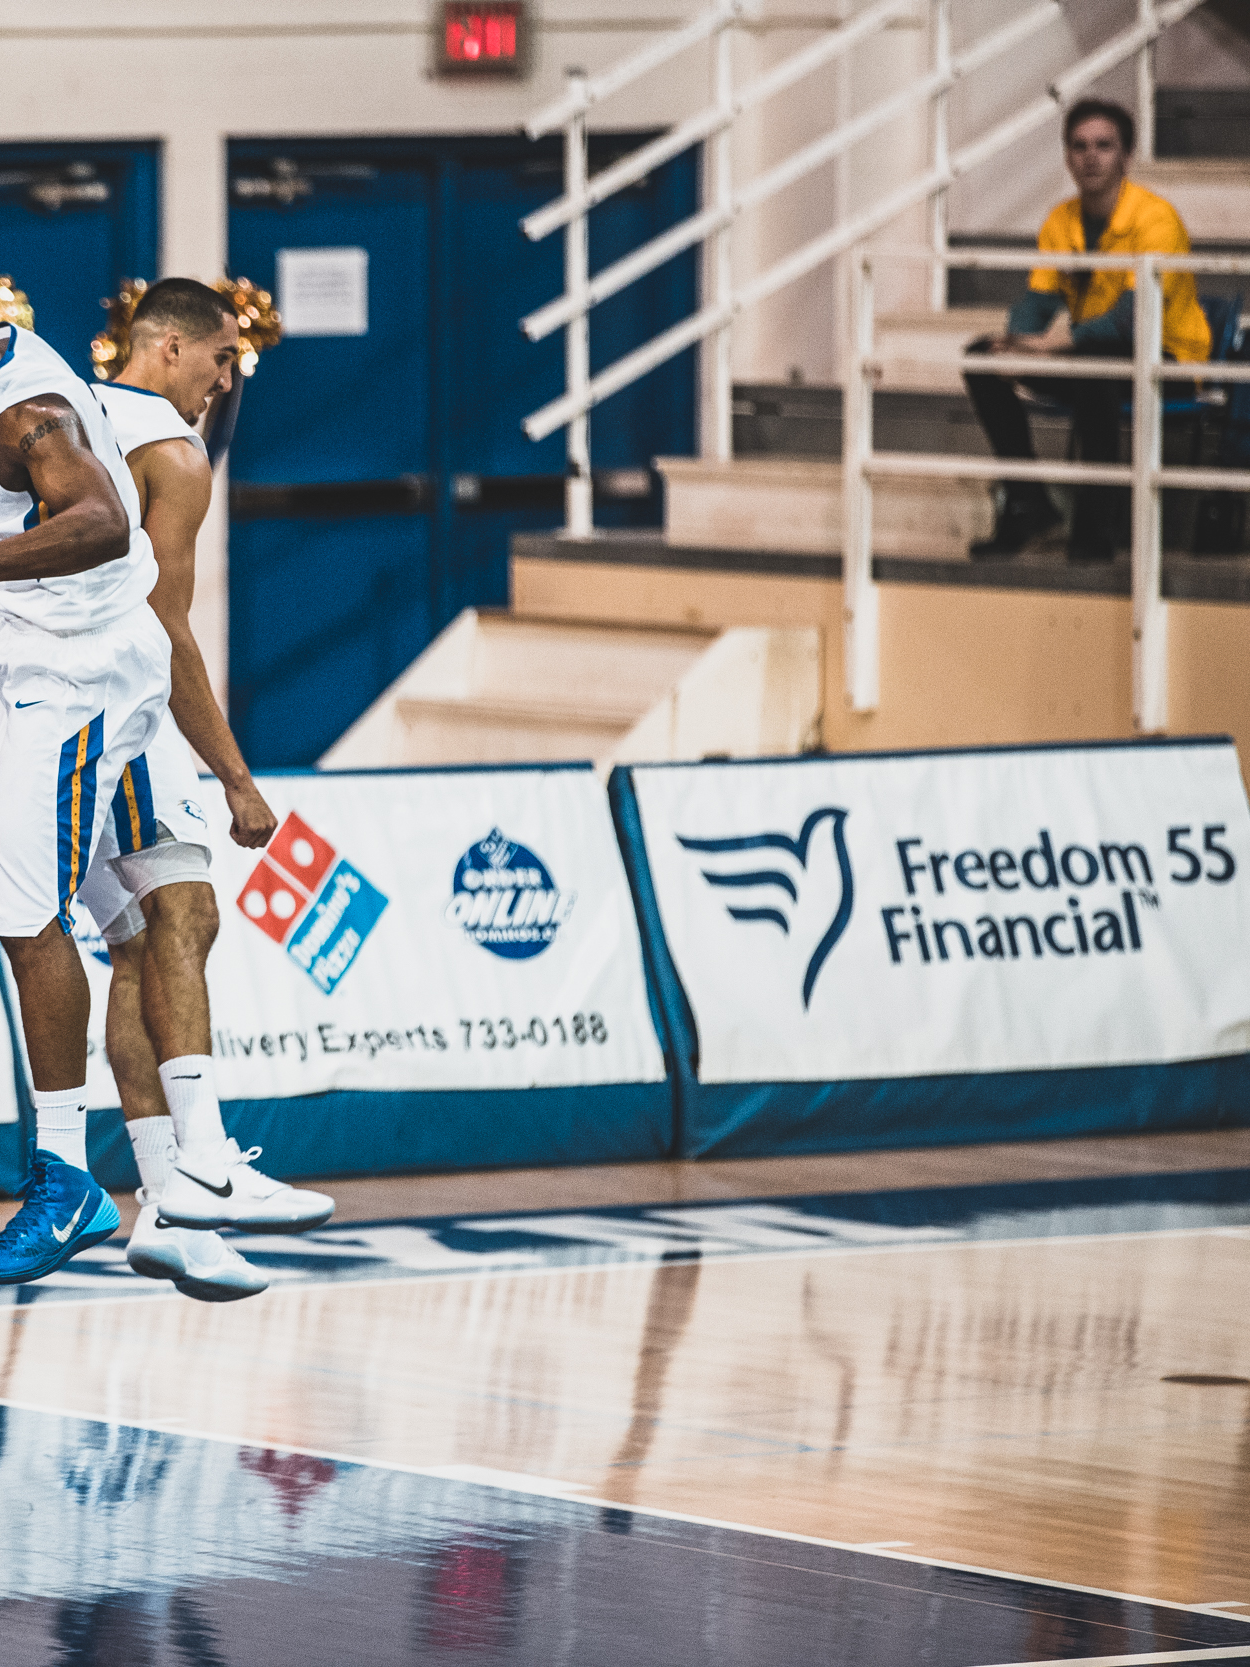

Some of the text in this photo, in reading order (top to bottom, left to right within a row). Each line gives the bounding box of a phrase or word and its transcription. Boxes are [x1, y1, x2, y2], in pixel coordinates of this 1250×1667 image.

[896, 824, 1235, 895] Freedom 55
[881, 889, 1142, 965] Financial
[216, 1010, 610, 1062] livery Experts 733-0188
